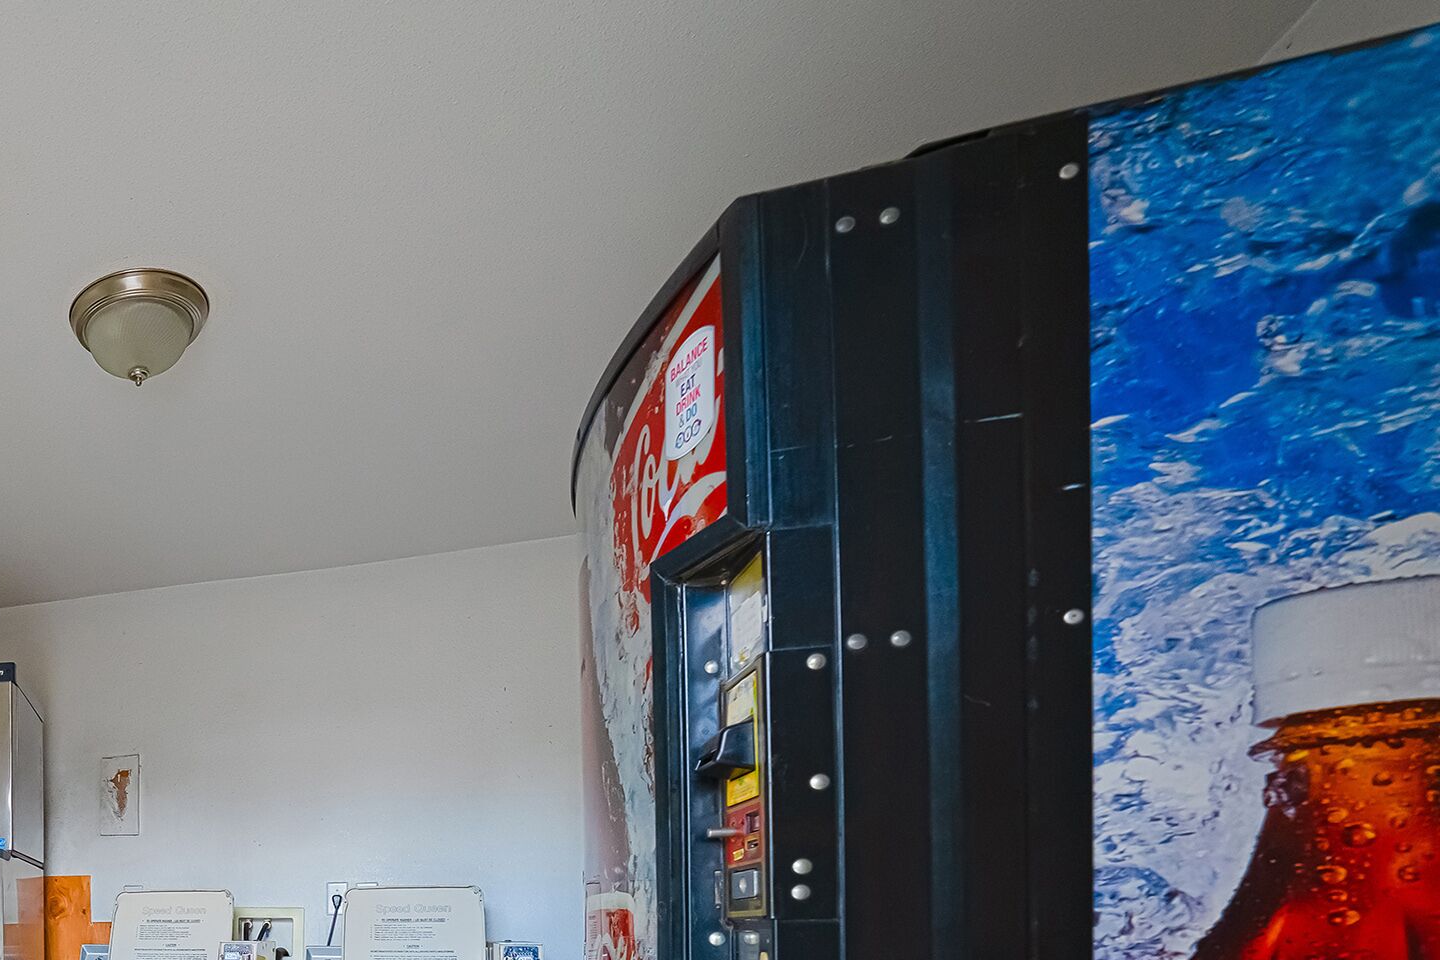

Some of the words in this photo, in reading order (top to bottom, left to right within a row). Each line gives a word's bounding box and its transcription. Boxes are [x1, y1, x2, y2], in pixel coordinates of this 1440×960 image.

[670, 336, 709, 383] BALANCE
[680, 373, 696, 397] EAT
[675, 384, 701, 416] DRINK
[685, 402, 698, 420] DO
[375, 904, 411, 915] Speed
[414, 904, 452, 914] Queen
